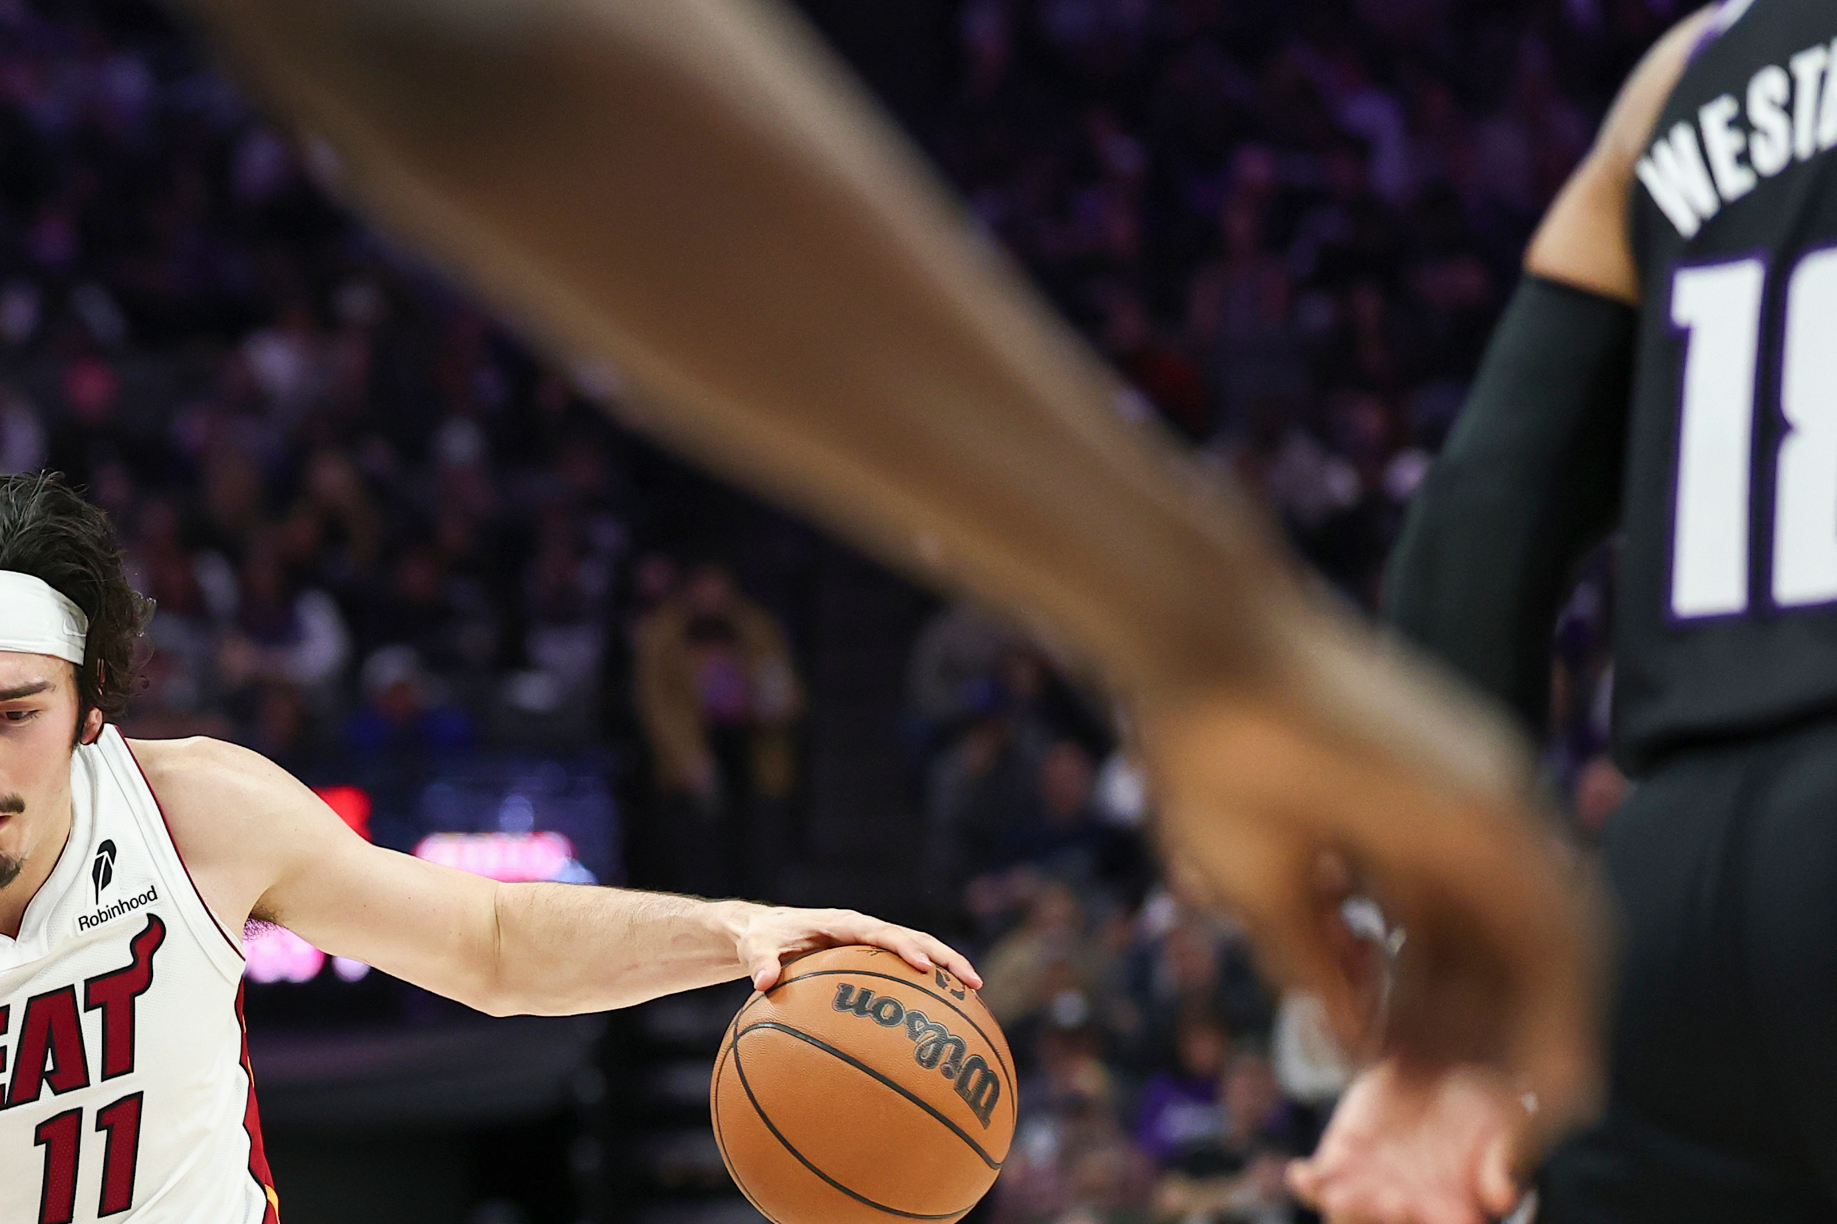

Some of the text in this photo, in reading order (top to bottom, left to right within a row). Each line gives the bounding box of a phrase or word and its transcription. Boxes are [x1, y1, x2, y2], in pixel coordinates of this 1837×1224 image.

[1637, 33, 1837, 240] WEST
[77, 884, 159, 932] Robinhood
[832, 983, 1000, 1130] Wilson
